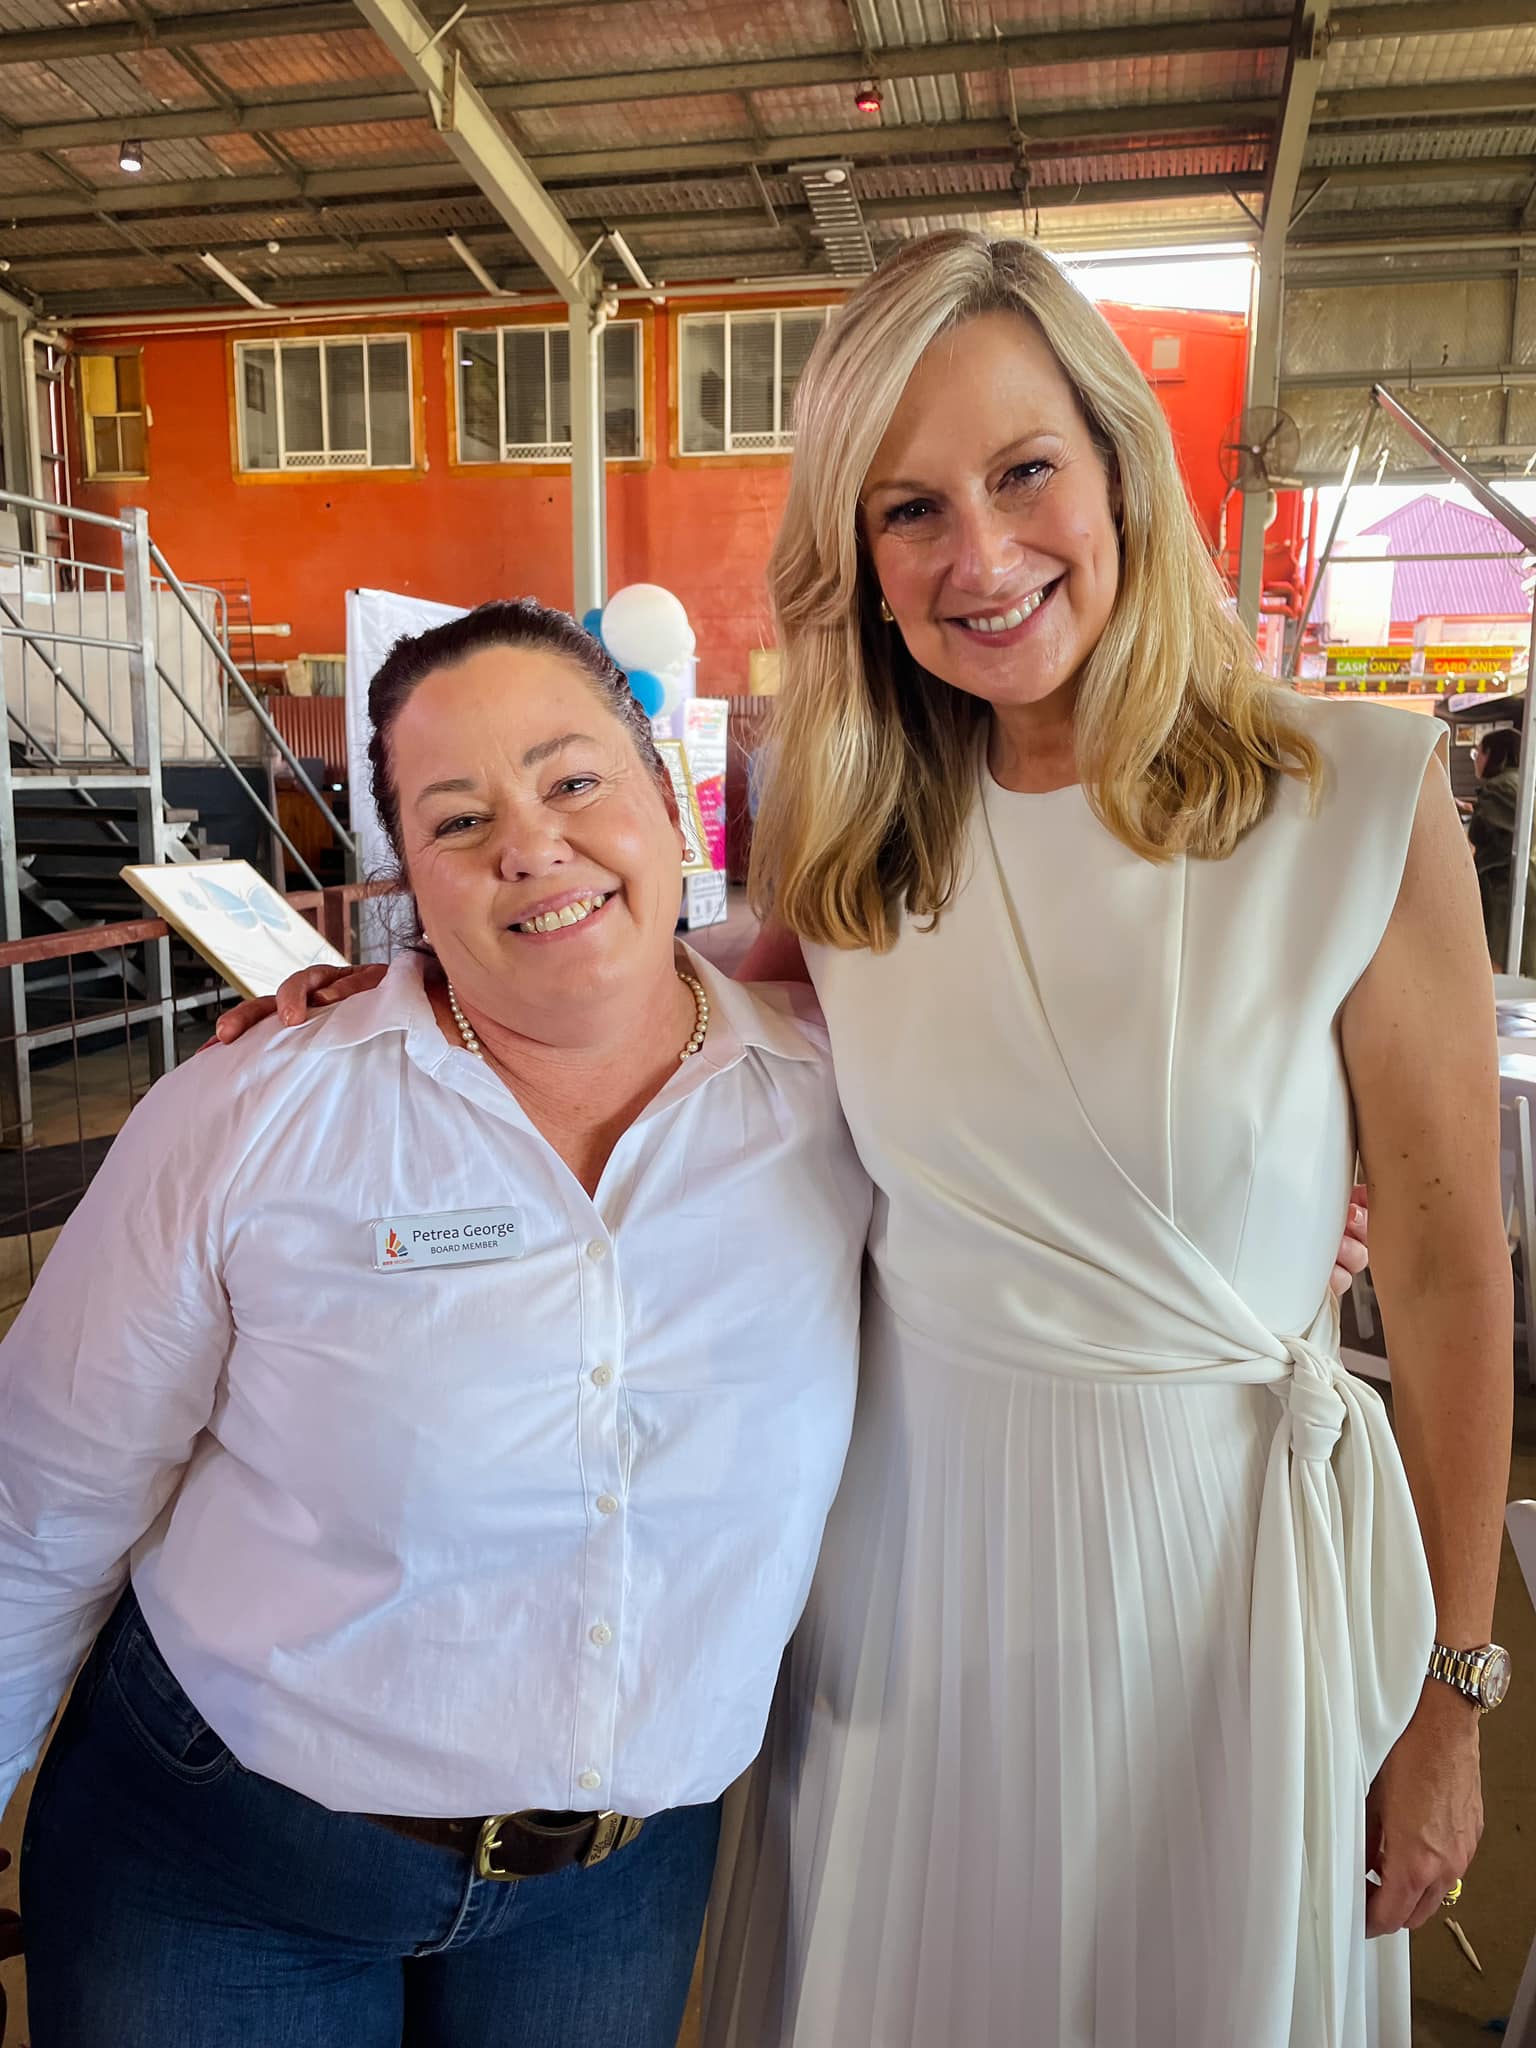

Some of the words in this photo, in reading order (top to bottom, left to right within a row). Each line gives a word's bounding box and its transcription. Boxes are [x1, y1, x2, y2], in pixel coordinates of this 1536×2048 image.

[1336, 661, 1367, 673] CASH
[1369, 661, 1399, 673] ONLY
[1434, 661, 1467, 673] CARD
[1470, 661, 1500, 673] ONLY
[412, 1228, 460, 1242] Petrea
[463, 1223, 515, 1238] George
[430, 1244, 461, 1254] BOARD
[462, 1240, 499, 1251] MEMBER
